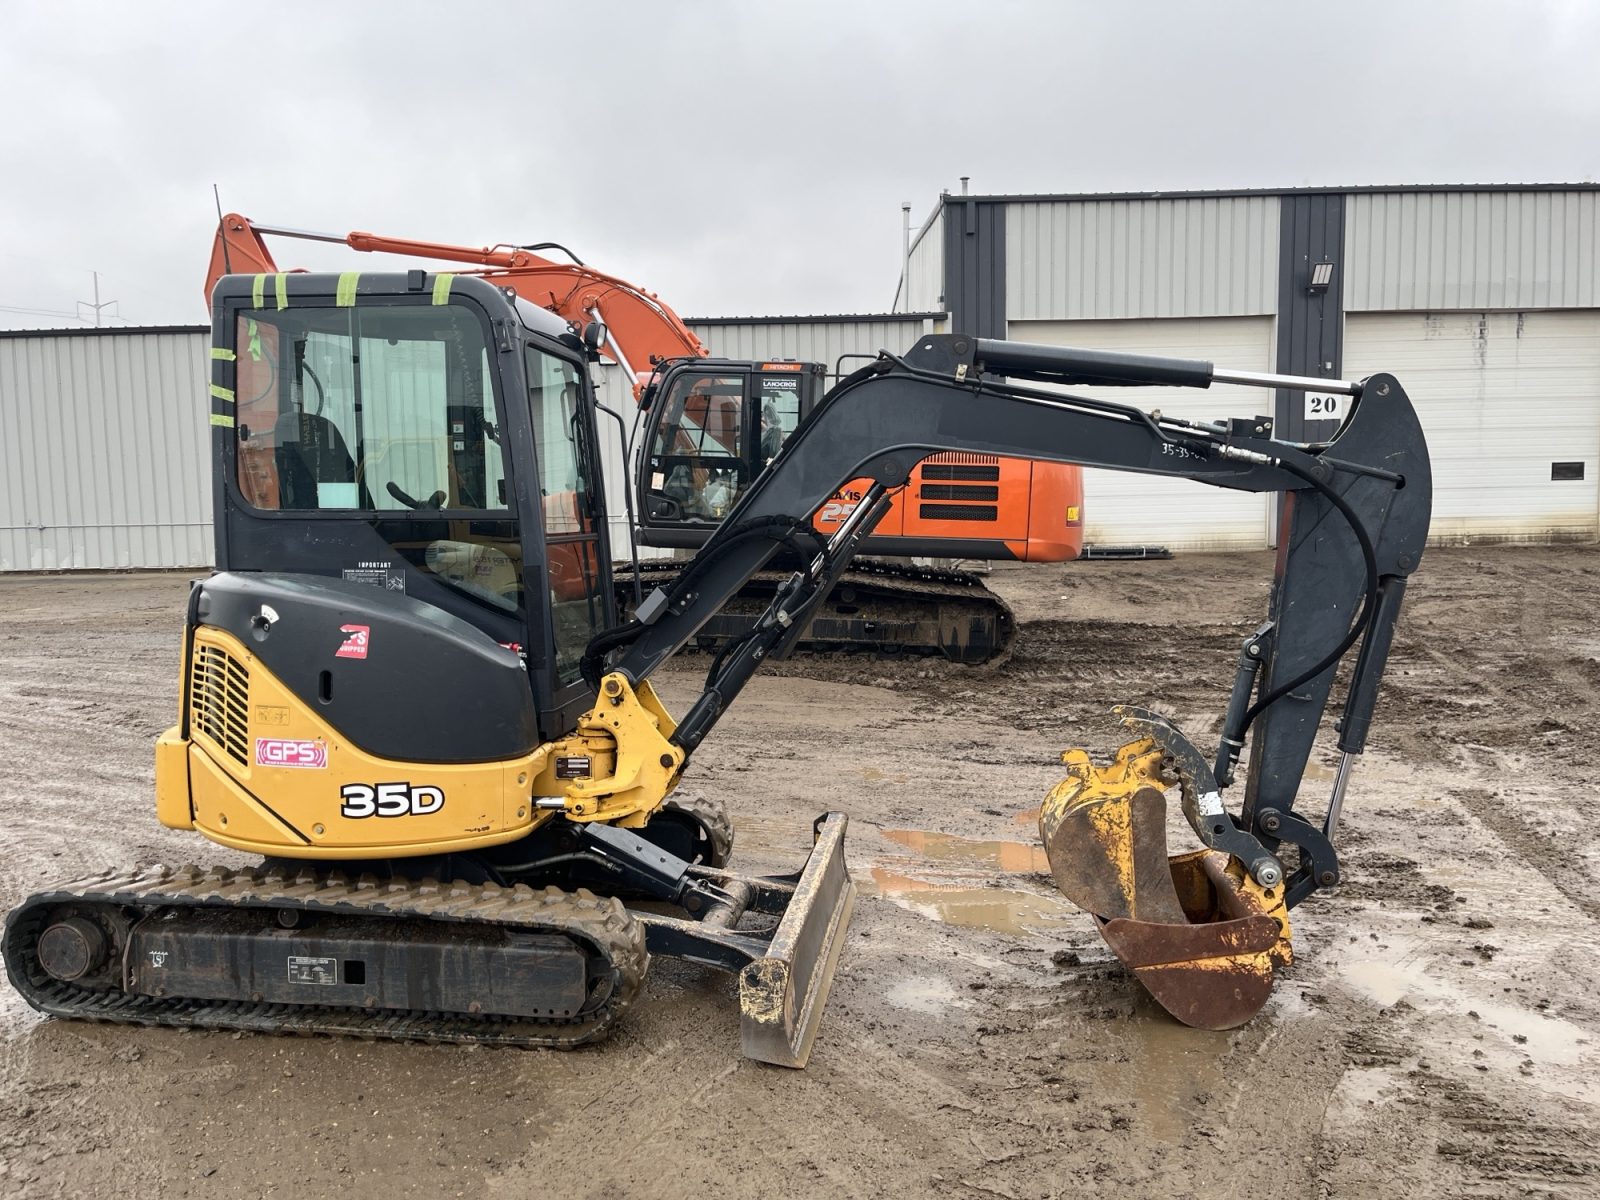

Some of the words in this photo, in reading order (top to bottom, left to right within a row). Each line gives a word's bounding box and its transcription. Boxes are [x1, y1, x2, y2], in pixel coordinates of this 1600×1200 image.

[1311, 397, 1337, 413] 20
[266, 741, 315, 762] GPS
[340, 782, 445, 819] 35D
